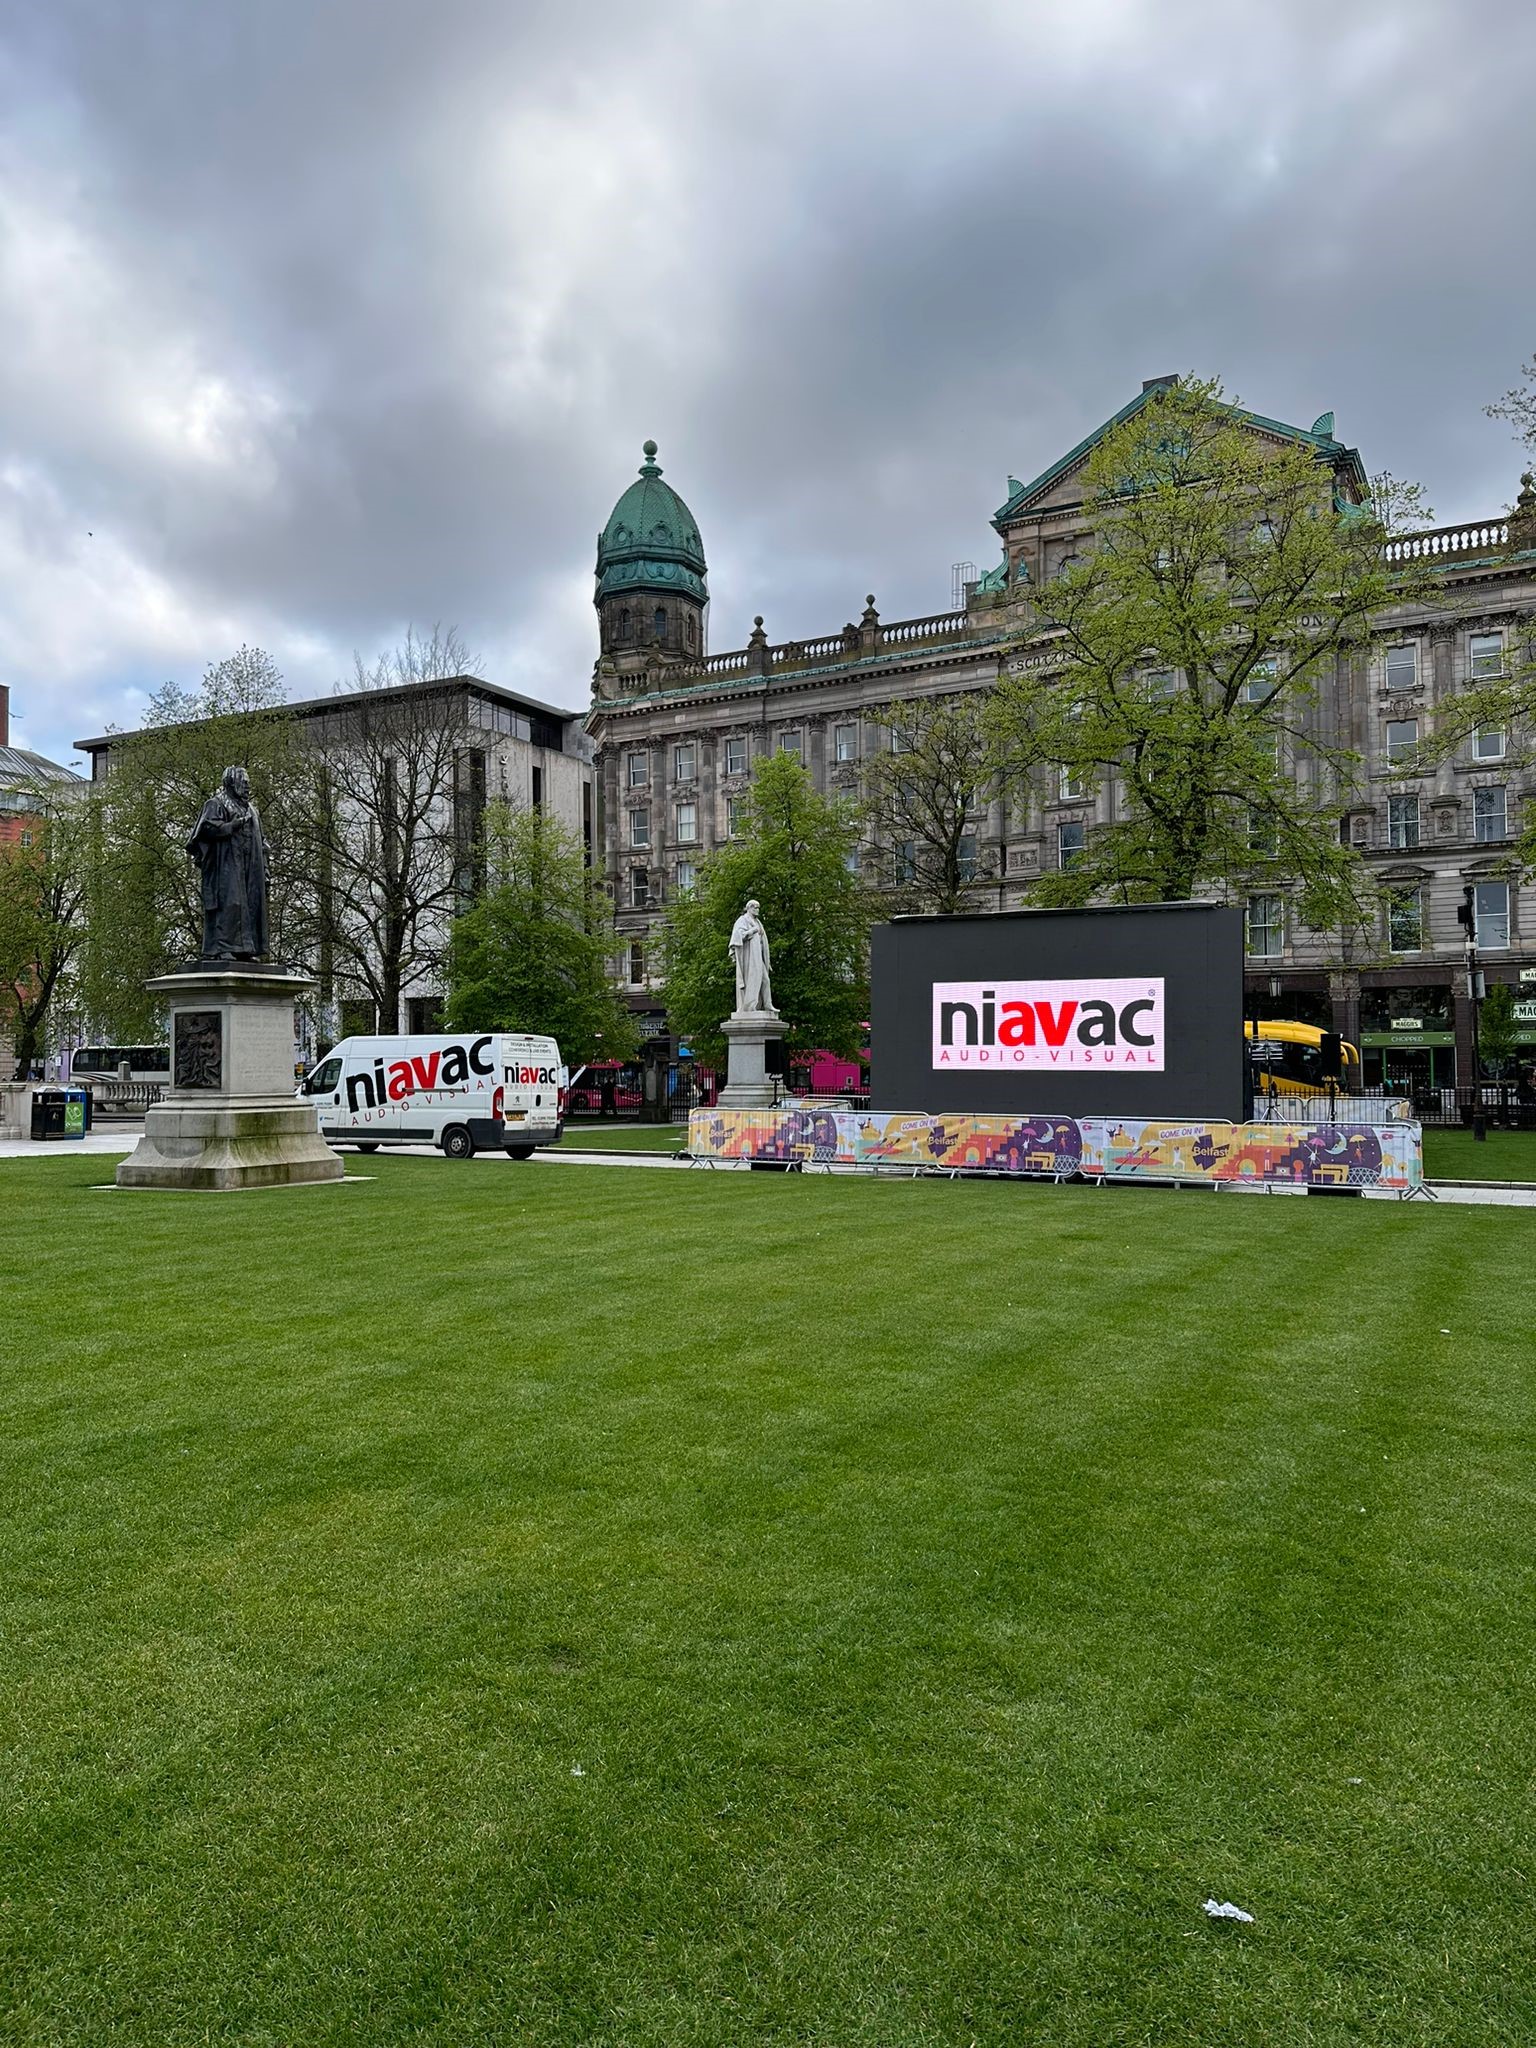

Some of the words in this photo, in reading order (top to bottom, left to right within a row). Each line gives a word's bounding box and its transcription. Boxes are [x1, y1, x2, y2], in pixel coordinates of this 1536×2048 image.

[941, 990, 1155, 1046] niavac
[346, 1036, 495, 1113] niavac
[504, 1062, 556, 1084] niavac
[902, 1121, 918, 1130] COME
[1160, 1129, 1180, 1139] COME
[928, 1136, 957, 1145] Belfast
[1193, 1146, 1228, 1156] Belfast
